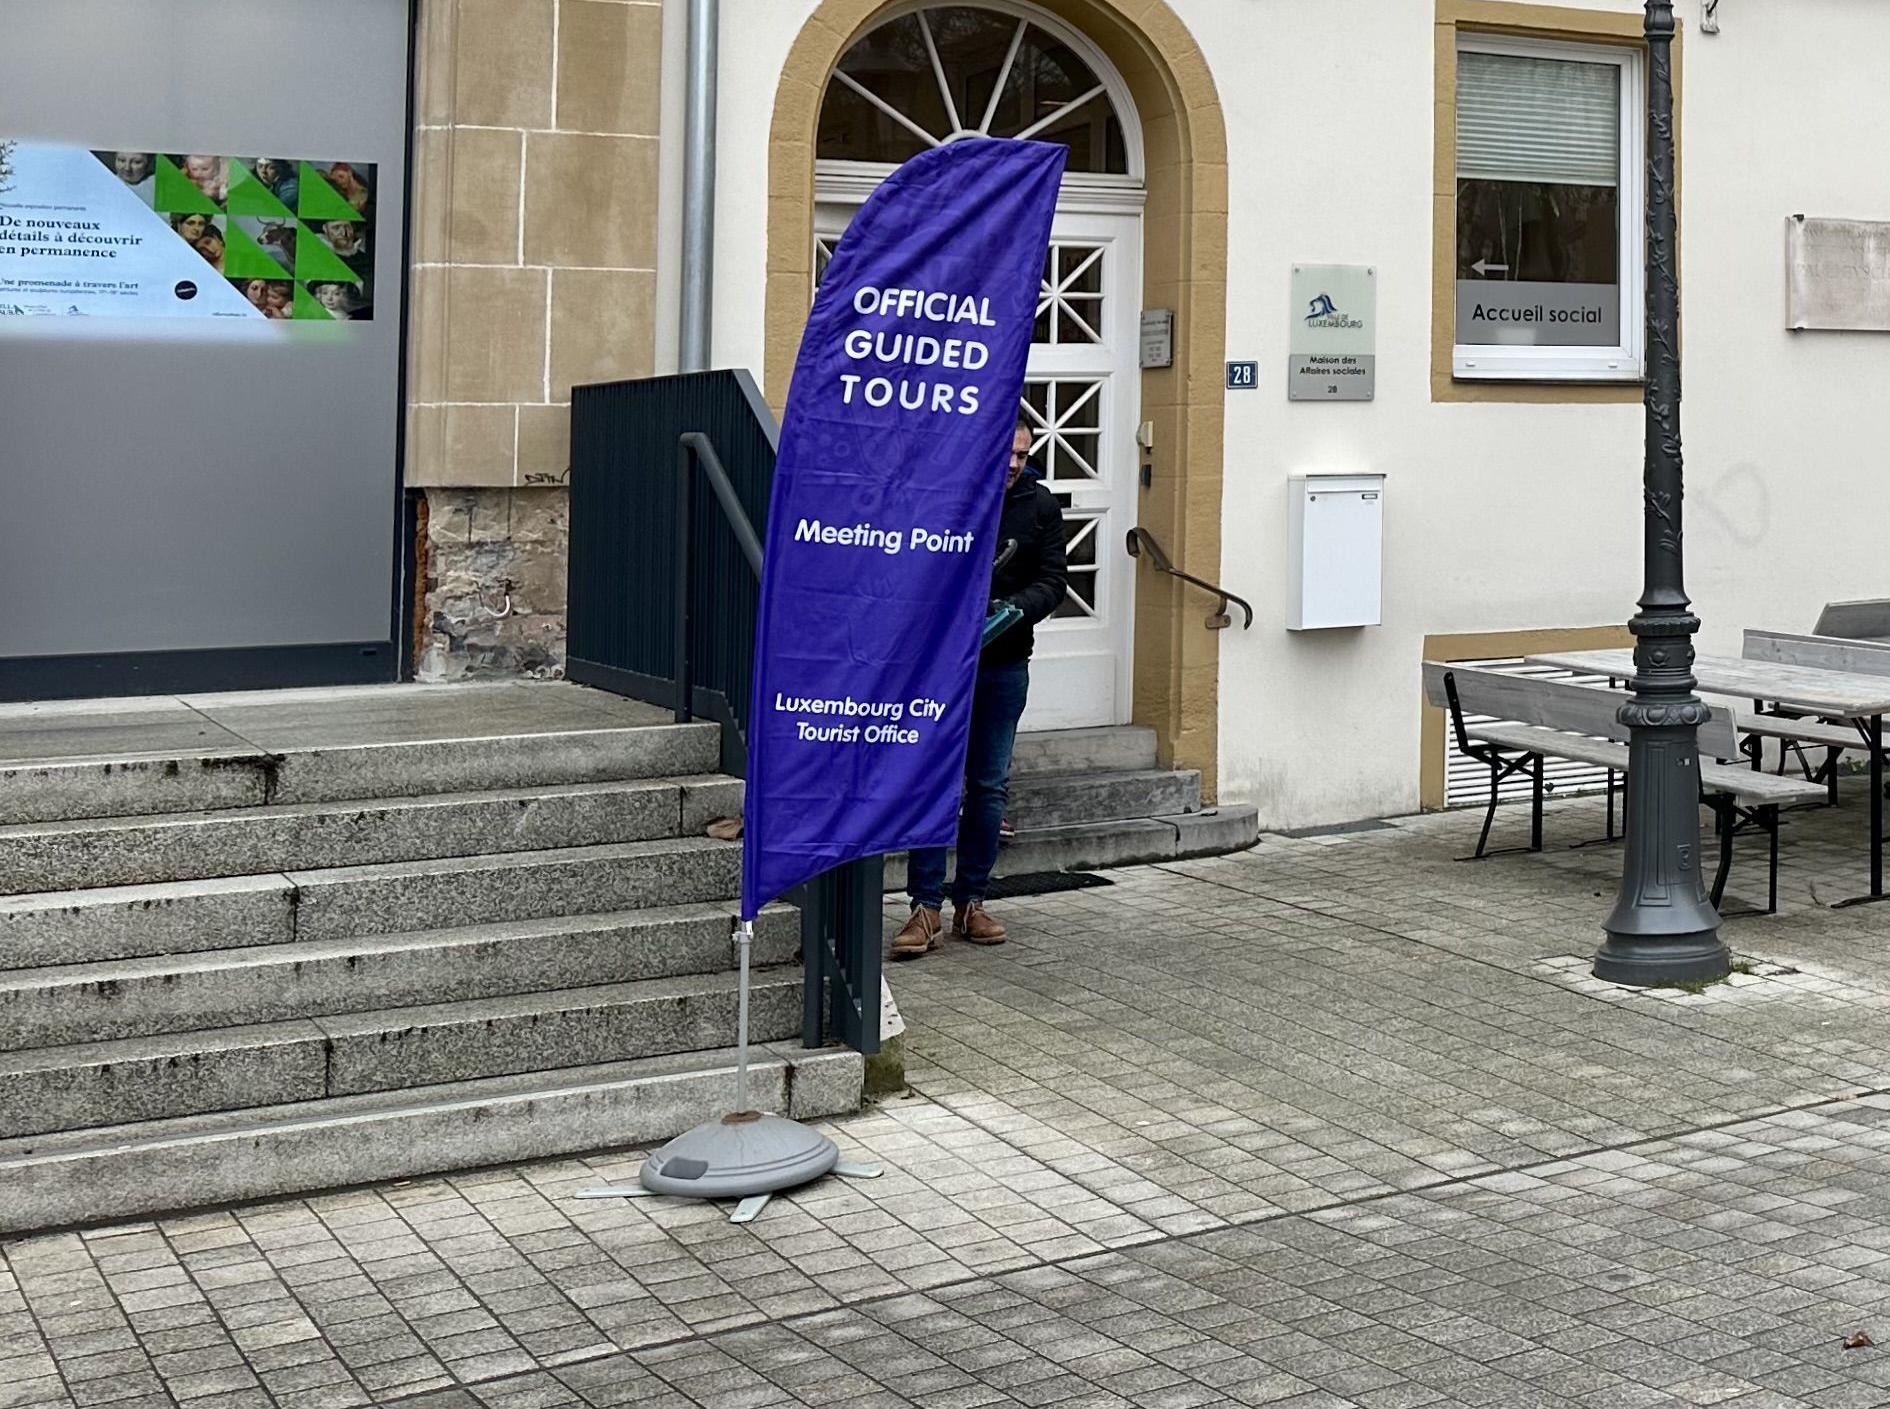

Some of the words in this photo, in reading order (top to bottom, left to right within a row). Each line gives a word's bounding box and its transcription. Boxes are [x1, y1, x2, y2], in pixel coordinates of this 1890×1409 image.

[0, 215, 22, 227] De
[26, 219, 101, 230] nouveaux
[0, 230, 50, 242] détails
[54, 233, 63, 242] à
[68, 232, 143, 245] découvrir
[20, 246, 117, 258] permanence
[18, 279, 72, 288] promenade
[83, 281, 116, 289] travers
[853, 286, 996, 326] OFFICIAL
[1472, 304, 1543, 322] Accueil
[1549, 306, 1602, 323] social
[1308, 319, 1363, 328] LUXEMBOURG
[844, 329, 989, 370] GUIDED
[1310, 357, 1339, 365] Maison
[1342, 357, 1357, 365] des
[1233, 366, 1251, 384] 28
[1299, 367, 1331, 375] Affaires
[1333, 367, 1366, 375] sociales
[839, 374, 980, 415] TOURS
[795, 518, 902, 554] Meeting
[909, 527, 975, 553] Point
[775, 692, 903, 721] Luxembourg
[909, 698, 946, 722] City
[797, 722, 861, 742] Tourist
[864, 724, 919, 743] Office
